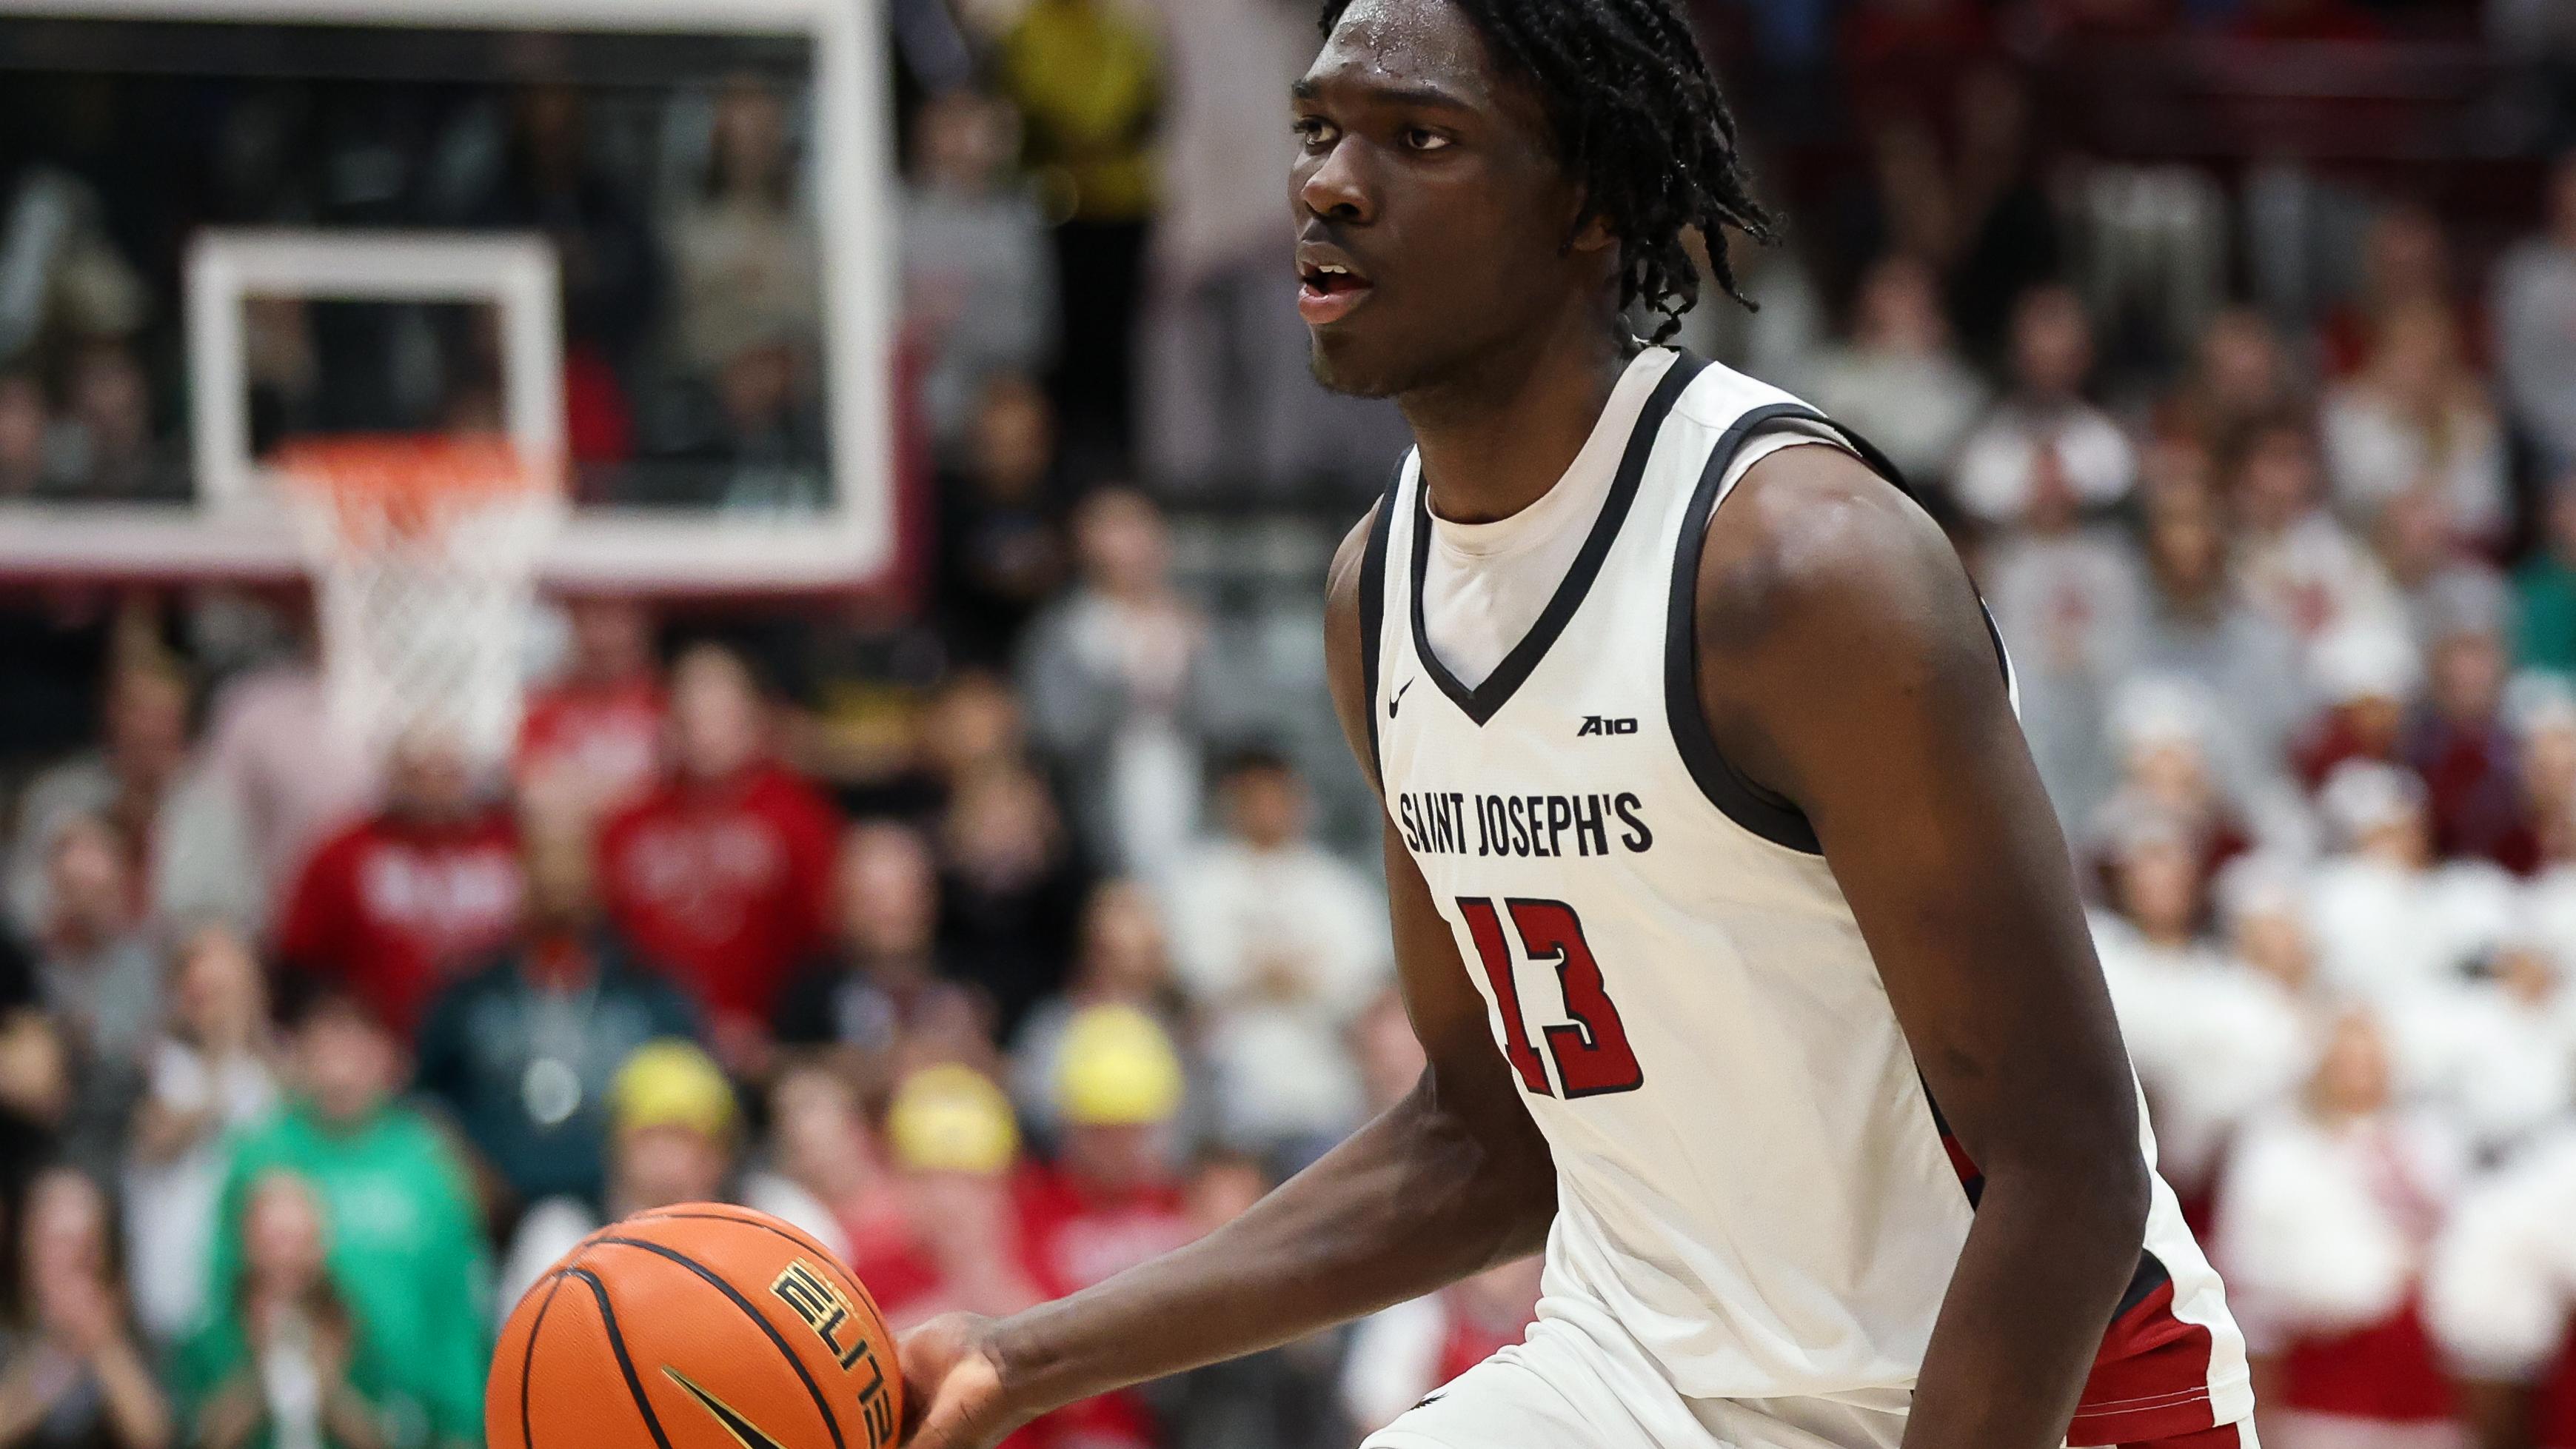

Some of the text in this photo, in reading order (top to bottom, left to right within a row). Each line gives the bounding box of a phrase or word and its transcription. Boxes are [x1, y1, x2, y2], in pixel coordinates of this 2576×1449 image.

[1576, 715, 1639, 737] A10
[1399, 792, 1653, 857] SAINT JOSEPH'S
[1454, 896, 1645, 1100] 13
[769, 1260, 894, 1449] ELITE
